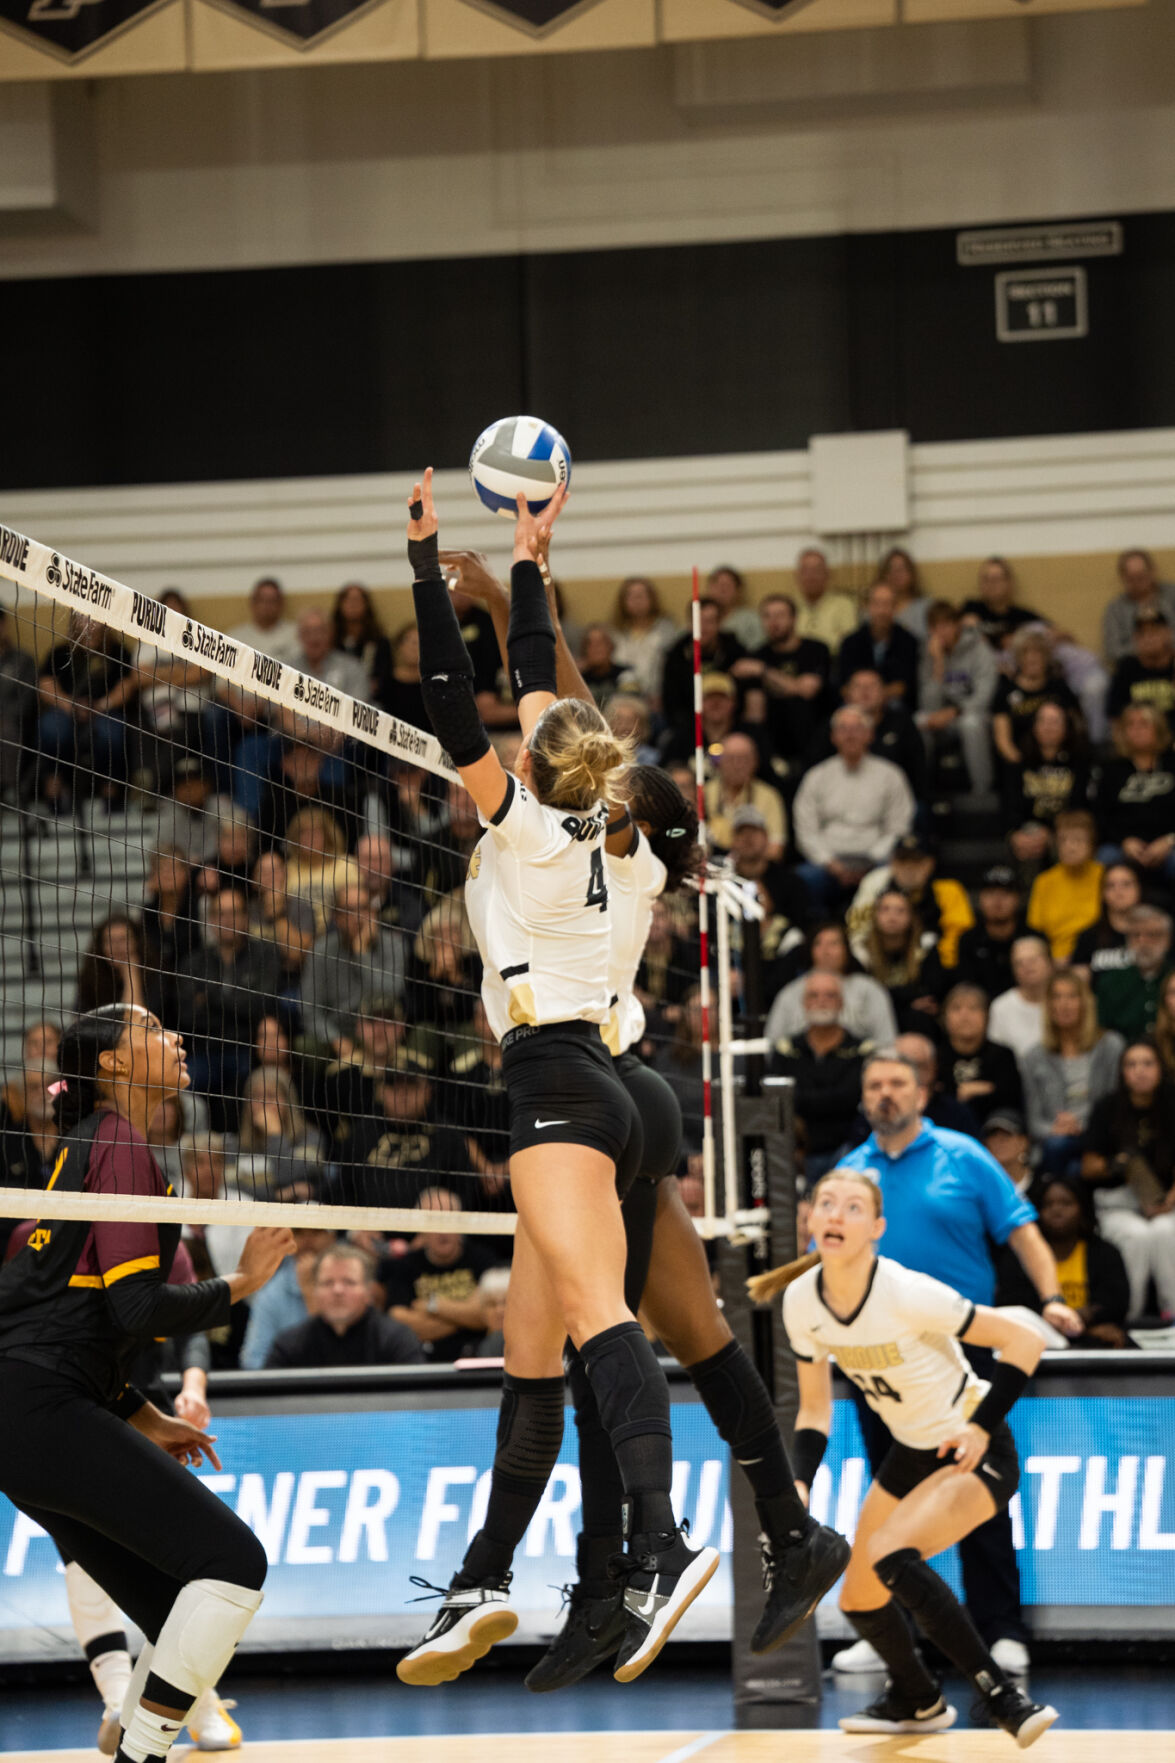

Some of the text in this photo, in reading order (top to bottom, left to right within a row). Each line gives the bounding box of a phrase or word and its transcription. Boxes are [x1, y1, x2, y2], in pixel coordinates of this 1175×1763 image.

[0, 526, 29, 572] RDUE
[131, 592, 168, 638] PURDUE
[251, 649, 283, 690] PURDUE
[352, 700, 380, 737] PURDUE
[584, 846, 608, 913] 4
[3, 1468, 400, 1577] PNER
[415, 1463, 583, 1560] FR
